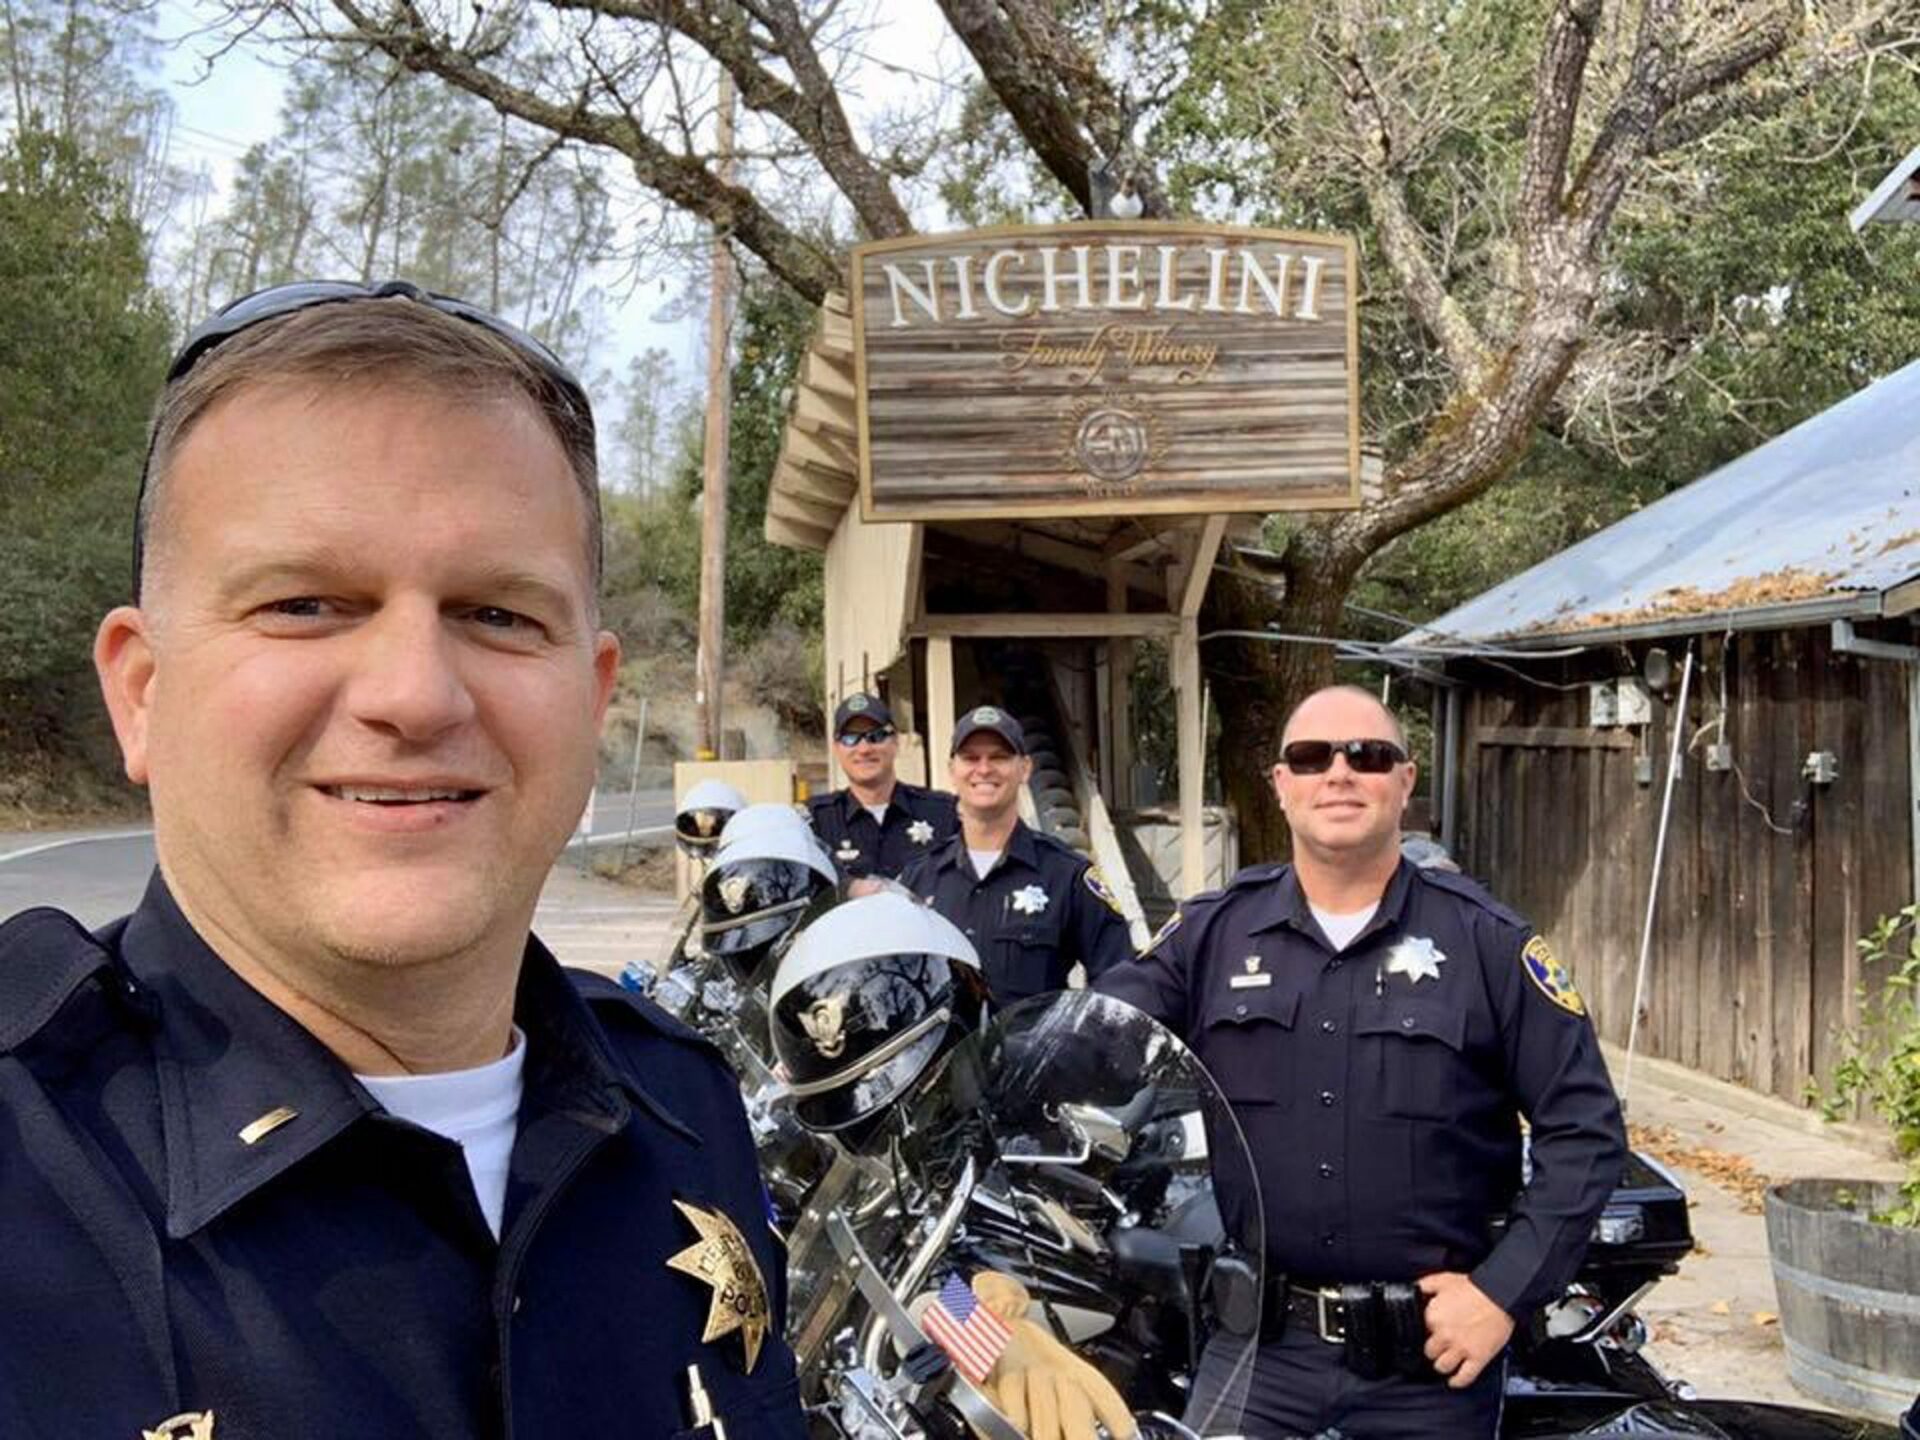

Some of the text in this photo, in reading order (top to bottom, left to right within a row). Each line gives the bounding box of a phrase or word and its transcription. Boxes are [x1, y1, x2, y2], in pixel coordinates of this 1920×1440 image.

[882, 244, 1325, 328] NICHELINI
[1001, 321, 1218, 386] Family Winery
